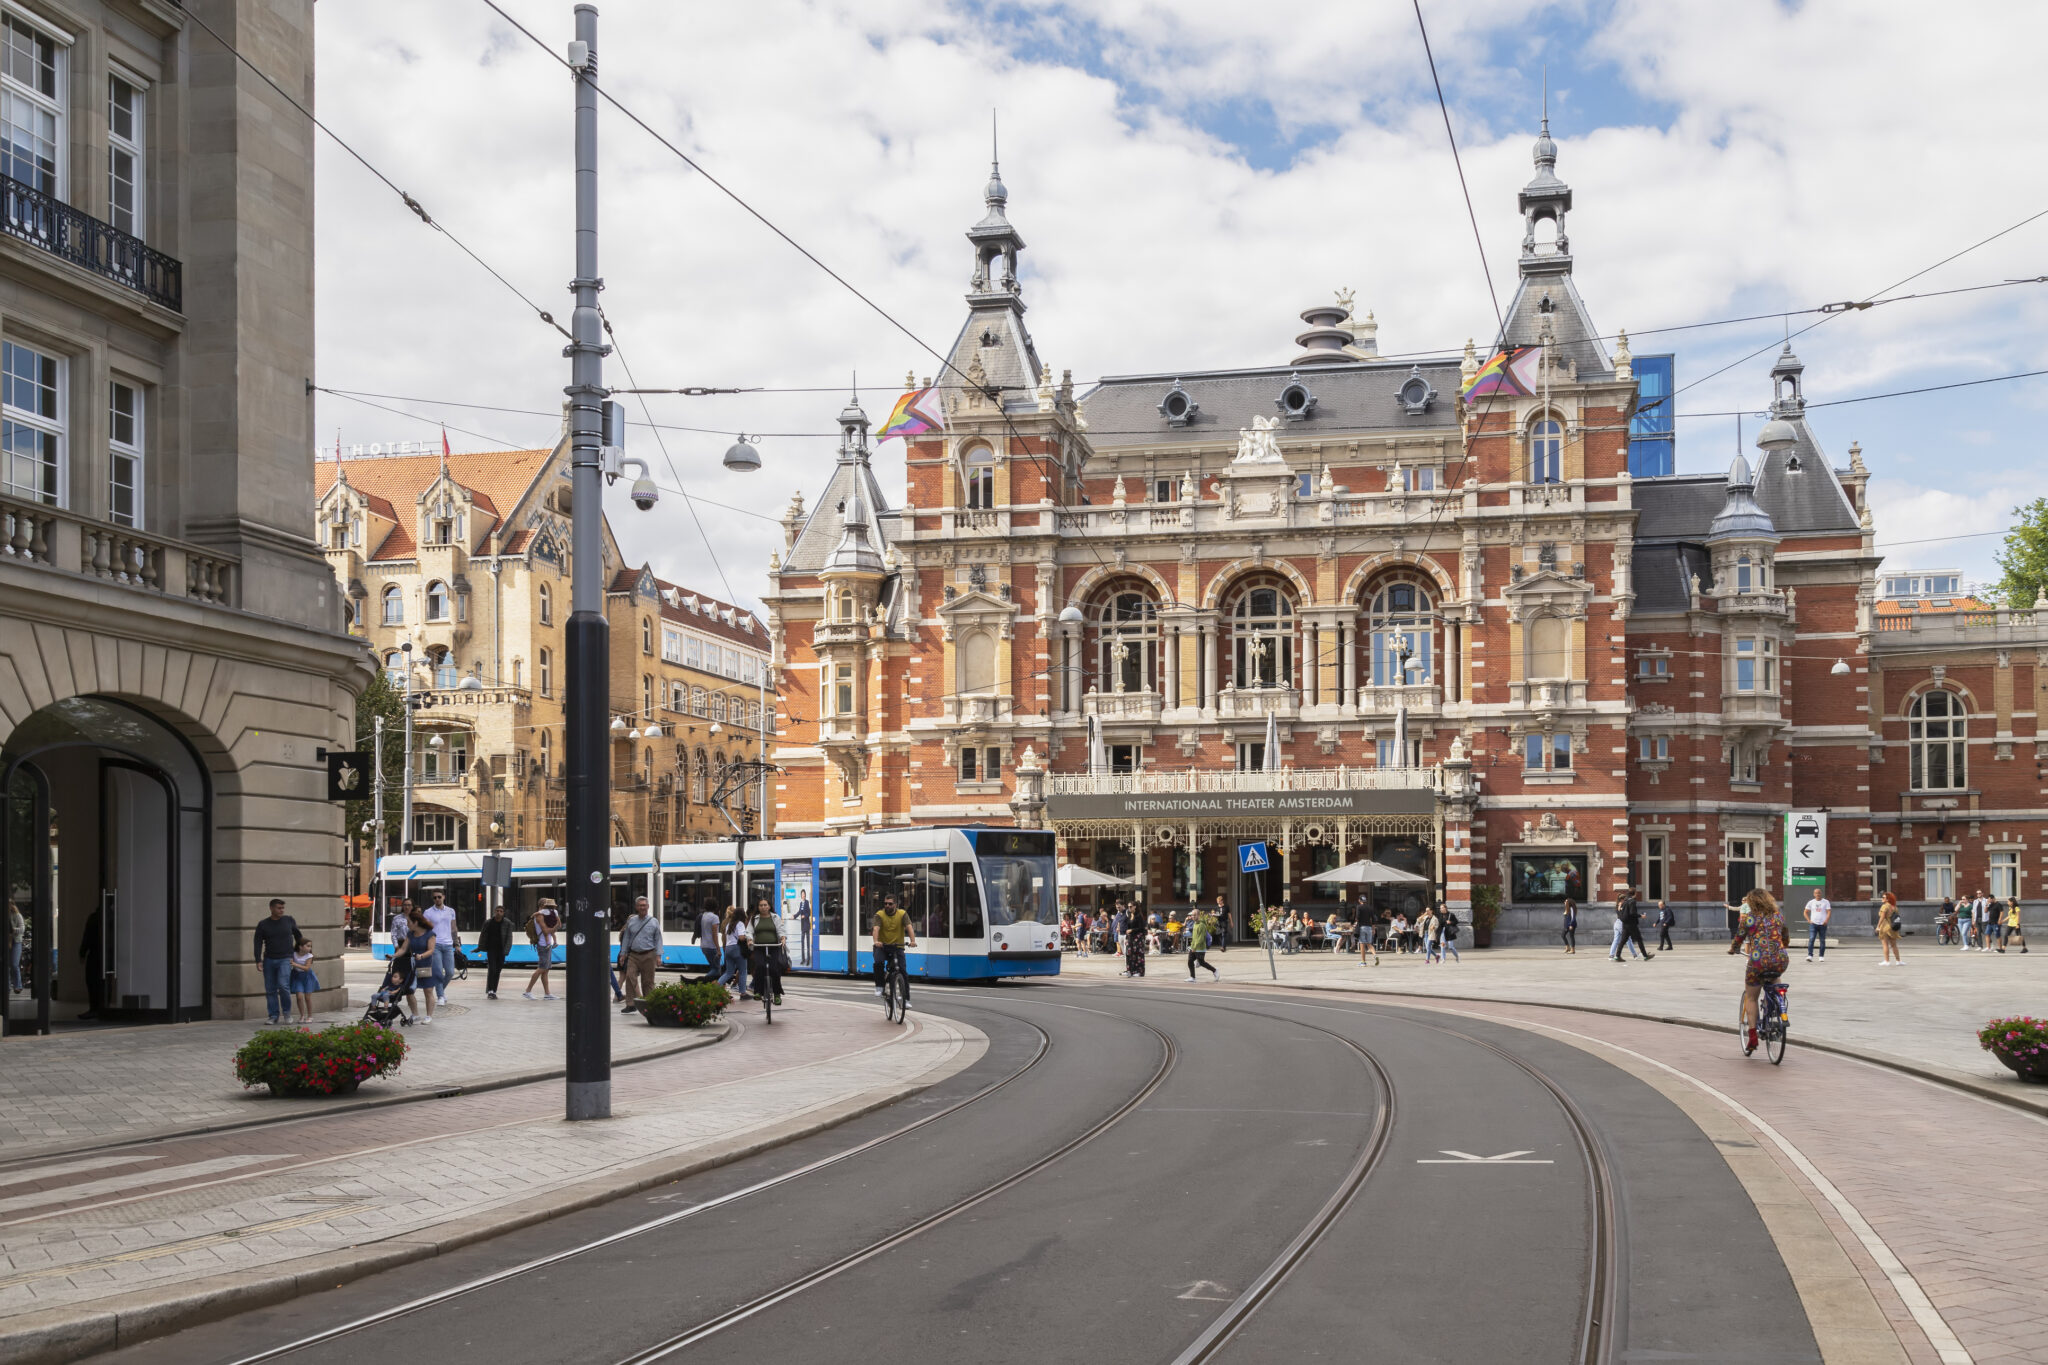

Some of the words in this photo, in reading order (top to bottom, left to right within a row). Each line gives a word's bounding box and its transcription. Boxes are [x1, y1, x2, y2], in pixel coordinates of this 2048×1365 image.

[353, 441, 431, 456] HOTEL
[1124, 799, 1222, 811] INTERNATIONAAL
[1226, 798, 1275, 809] THEATER
[1278, 797, 1354, 809] AMSTERDAM
[1012, 836, 1018, 848] 2
